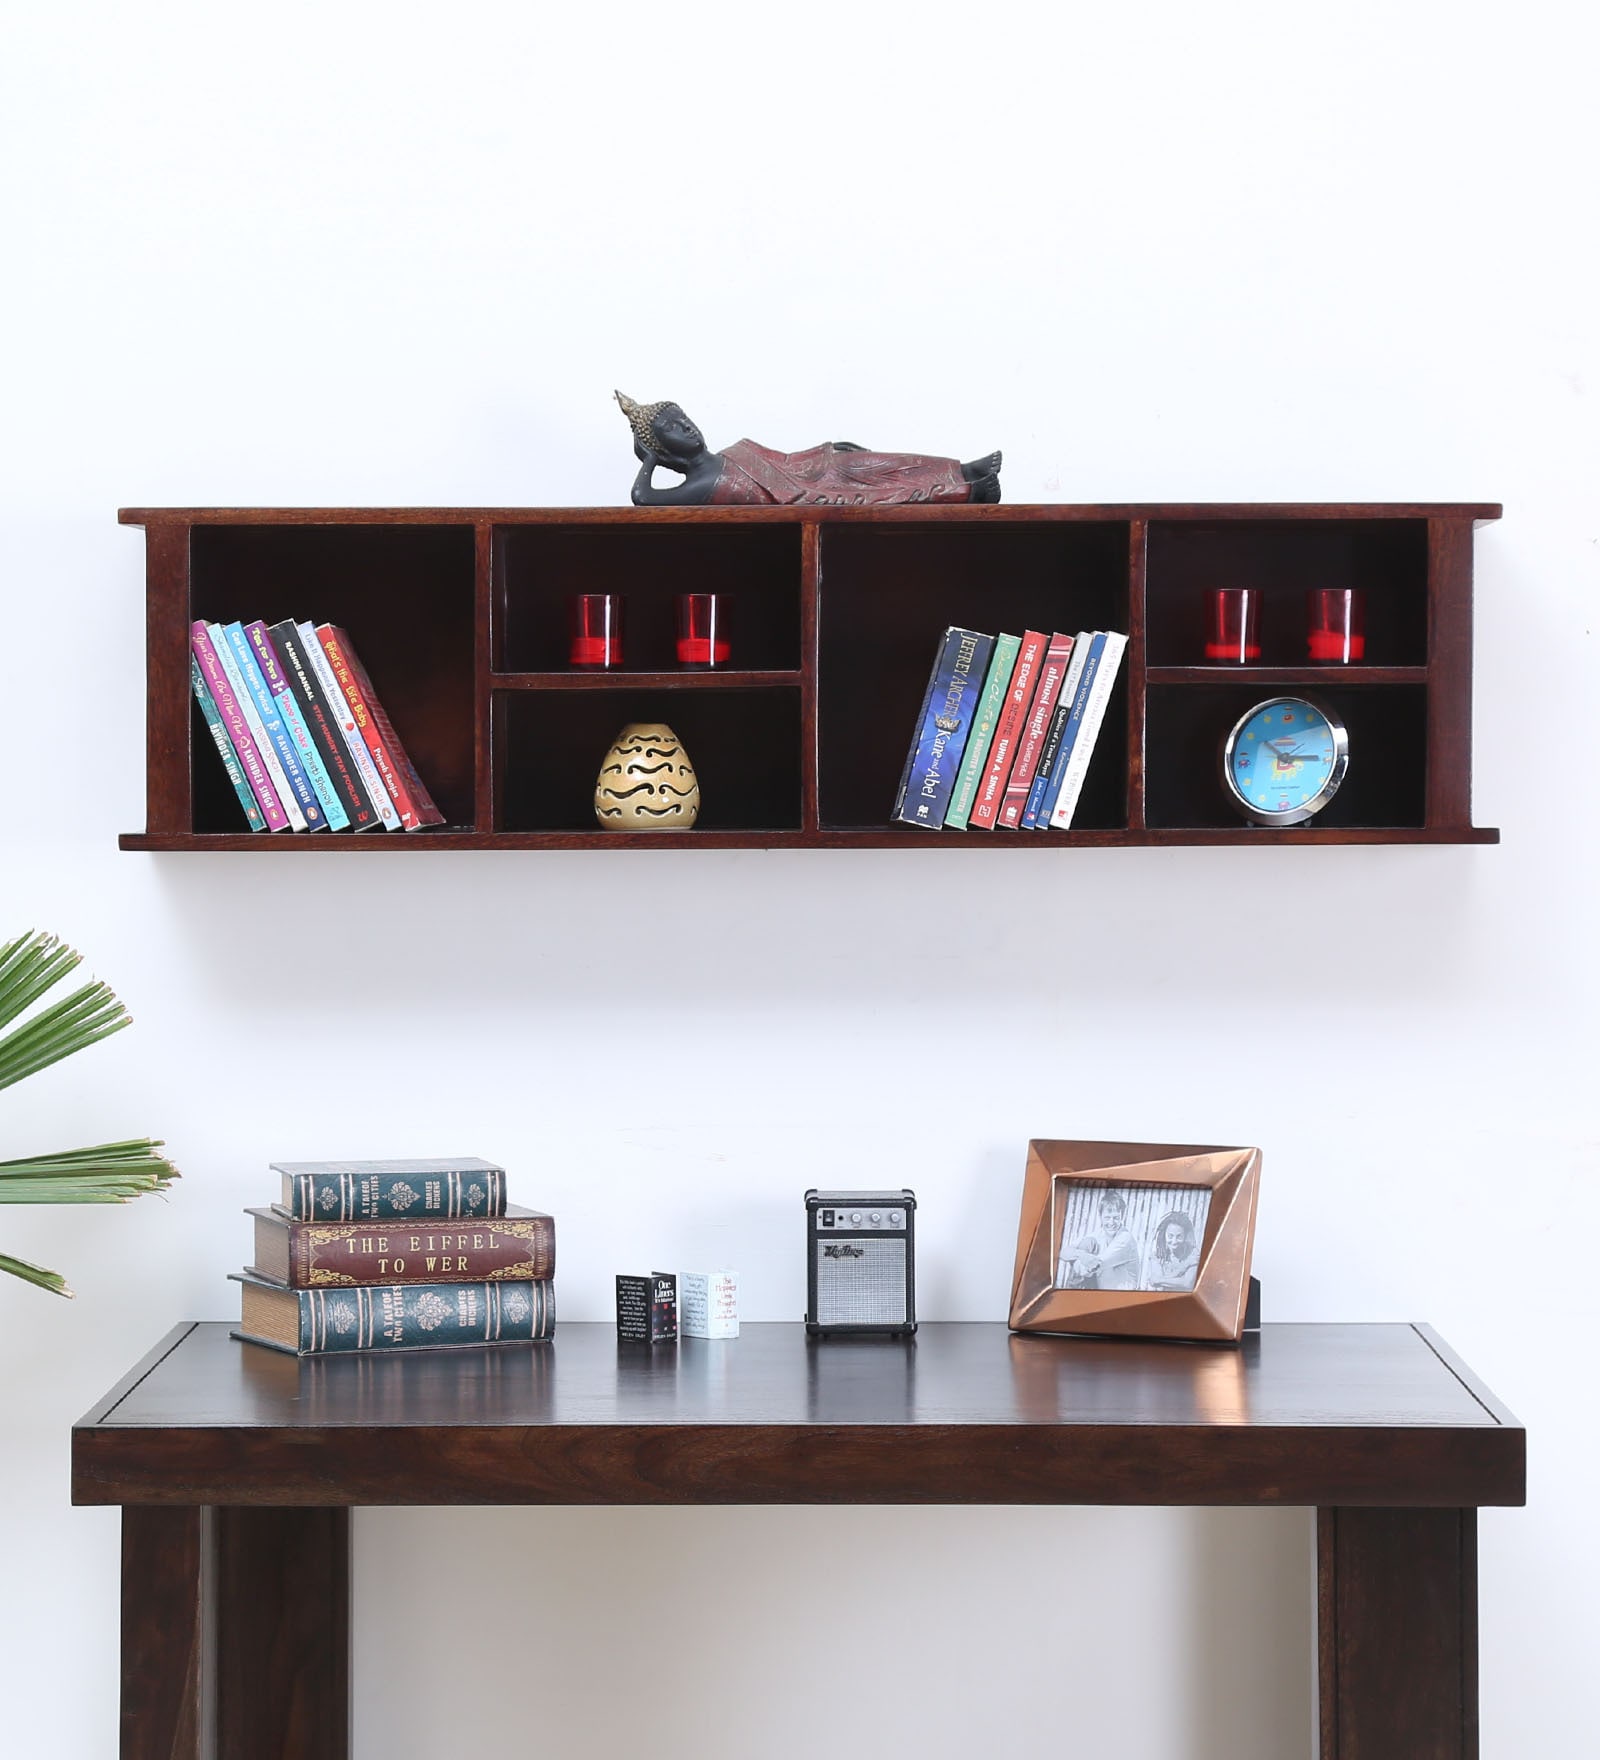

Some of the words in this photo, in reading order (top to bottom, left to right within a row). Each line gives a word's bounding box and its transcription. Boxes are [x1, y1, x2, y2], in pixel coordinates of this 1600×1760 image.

[230, 630, 243, 646] Can
[250, 626, 264, 646] Tea
[236, 645, 250, 664] Love
[258, 645, 270, 660] for
[950, 632, 978, 677] JEFFREY
[1023, 642, 1037, 662] THE
[243, 662, 262, 690] Happen
[263, 658, 279, 680] Two
[284, 640, 302, 671] RASHMI
[296, 669, 315, 702] BANSAL
[304, 632, 316, 649] Like
[312, 653, 333, 688] Happened
[328, 687, 347, 720] Yesterday
[1016, 662, 1031, 688] EDGE
[1082, 656, 1096, 686] BEYOND
[942, 675, 968, 718] ARCHER
[1012, 688, 1023, 702] OF
[1039, 666, 1061, 706] almost
[255, 688, 274, 715] Twice?
[280, 693, 296, 717] Piece
[1072, 686, 1087, 721] VIOLENCE
[1026, 704, 1049, 740] single
[293, 725, 309, 749] Cake
[930, 728, 951, 760] Kane
[994, 737, 1009, 763] TUHIN
[209, 722, 231, 761] RAVINDER
[224, 760, 242, 786] SINGH
[311, 703, 325, 723] STAY
[320, 722, 338, 754] HUNGRY
[333, 754, 347, 774] STAY
[341, 773, 361, 807] FOOLISH
[930, 757, 940, 770] and
[1045, 744, 1055, 759] Team
[243, 748, 264, 784] RAVINDER
[258, 784, 274, 808] SINGH
[275, 733, 299, 776] RAVINDER
[293, 775, 311, 804] SINGH
[352, 741, 373, 779] RAVINDER
[369, 779, 385, 805] SINGH
[991, 763, 1001, 774] A.
[1039, 758, 1051, 776] Player
[382, 772, 400, 799] Ranjan
[920, 767, 943, 799] Abel
[983, 774, 999, 802] SINHA
[371, 1175, 379, 1200] CITIES
[346, 1237, 389, 1254] THE
[410, 1234, 499, 1252] EIFFEL
[378, 1258, 405, 1274] TO
[426, 1256, 468, 1272] WER
[658, 1280, 671, 1289] One
[393, 1286, 404, 1317] CITIES
